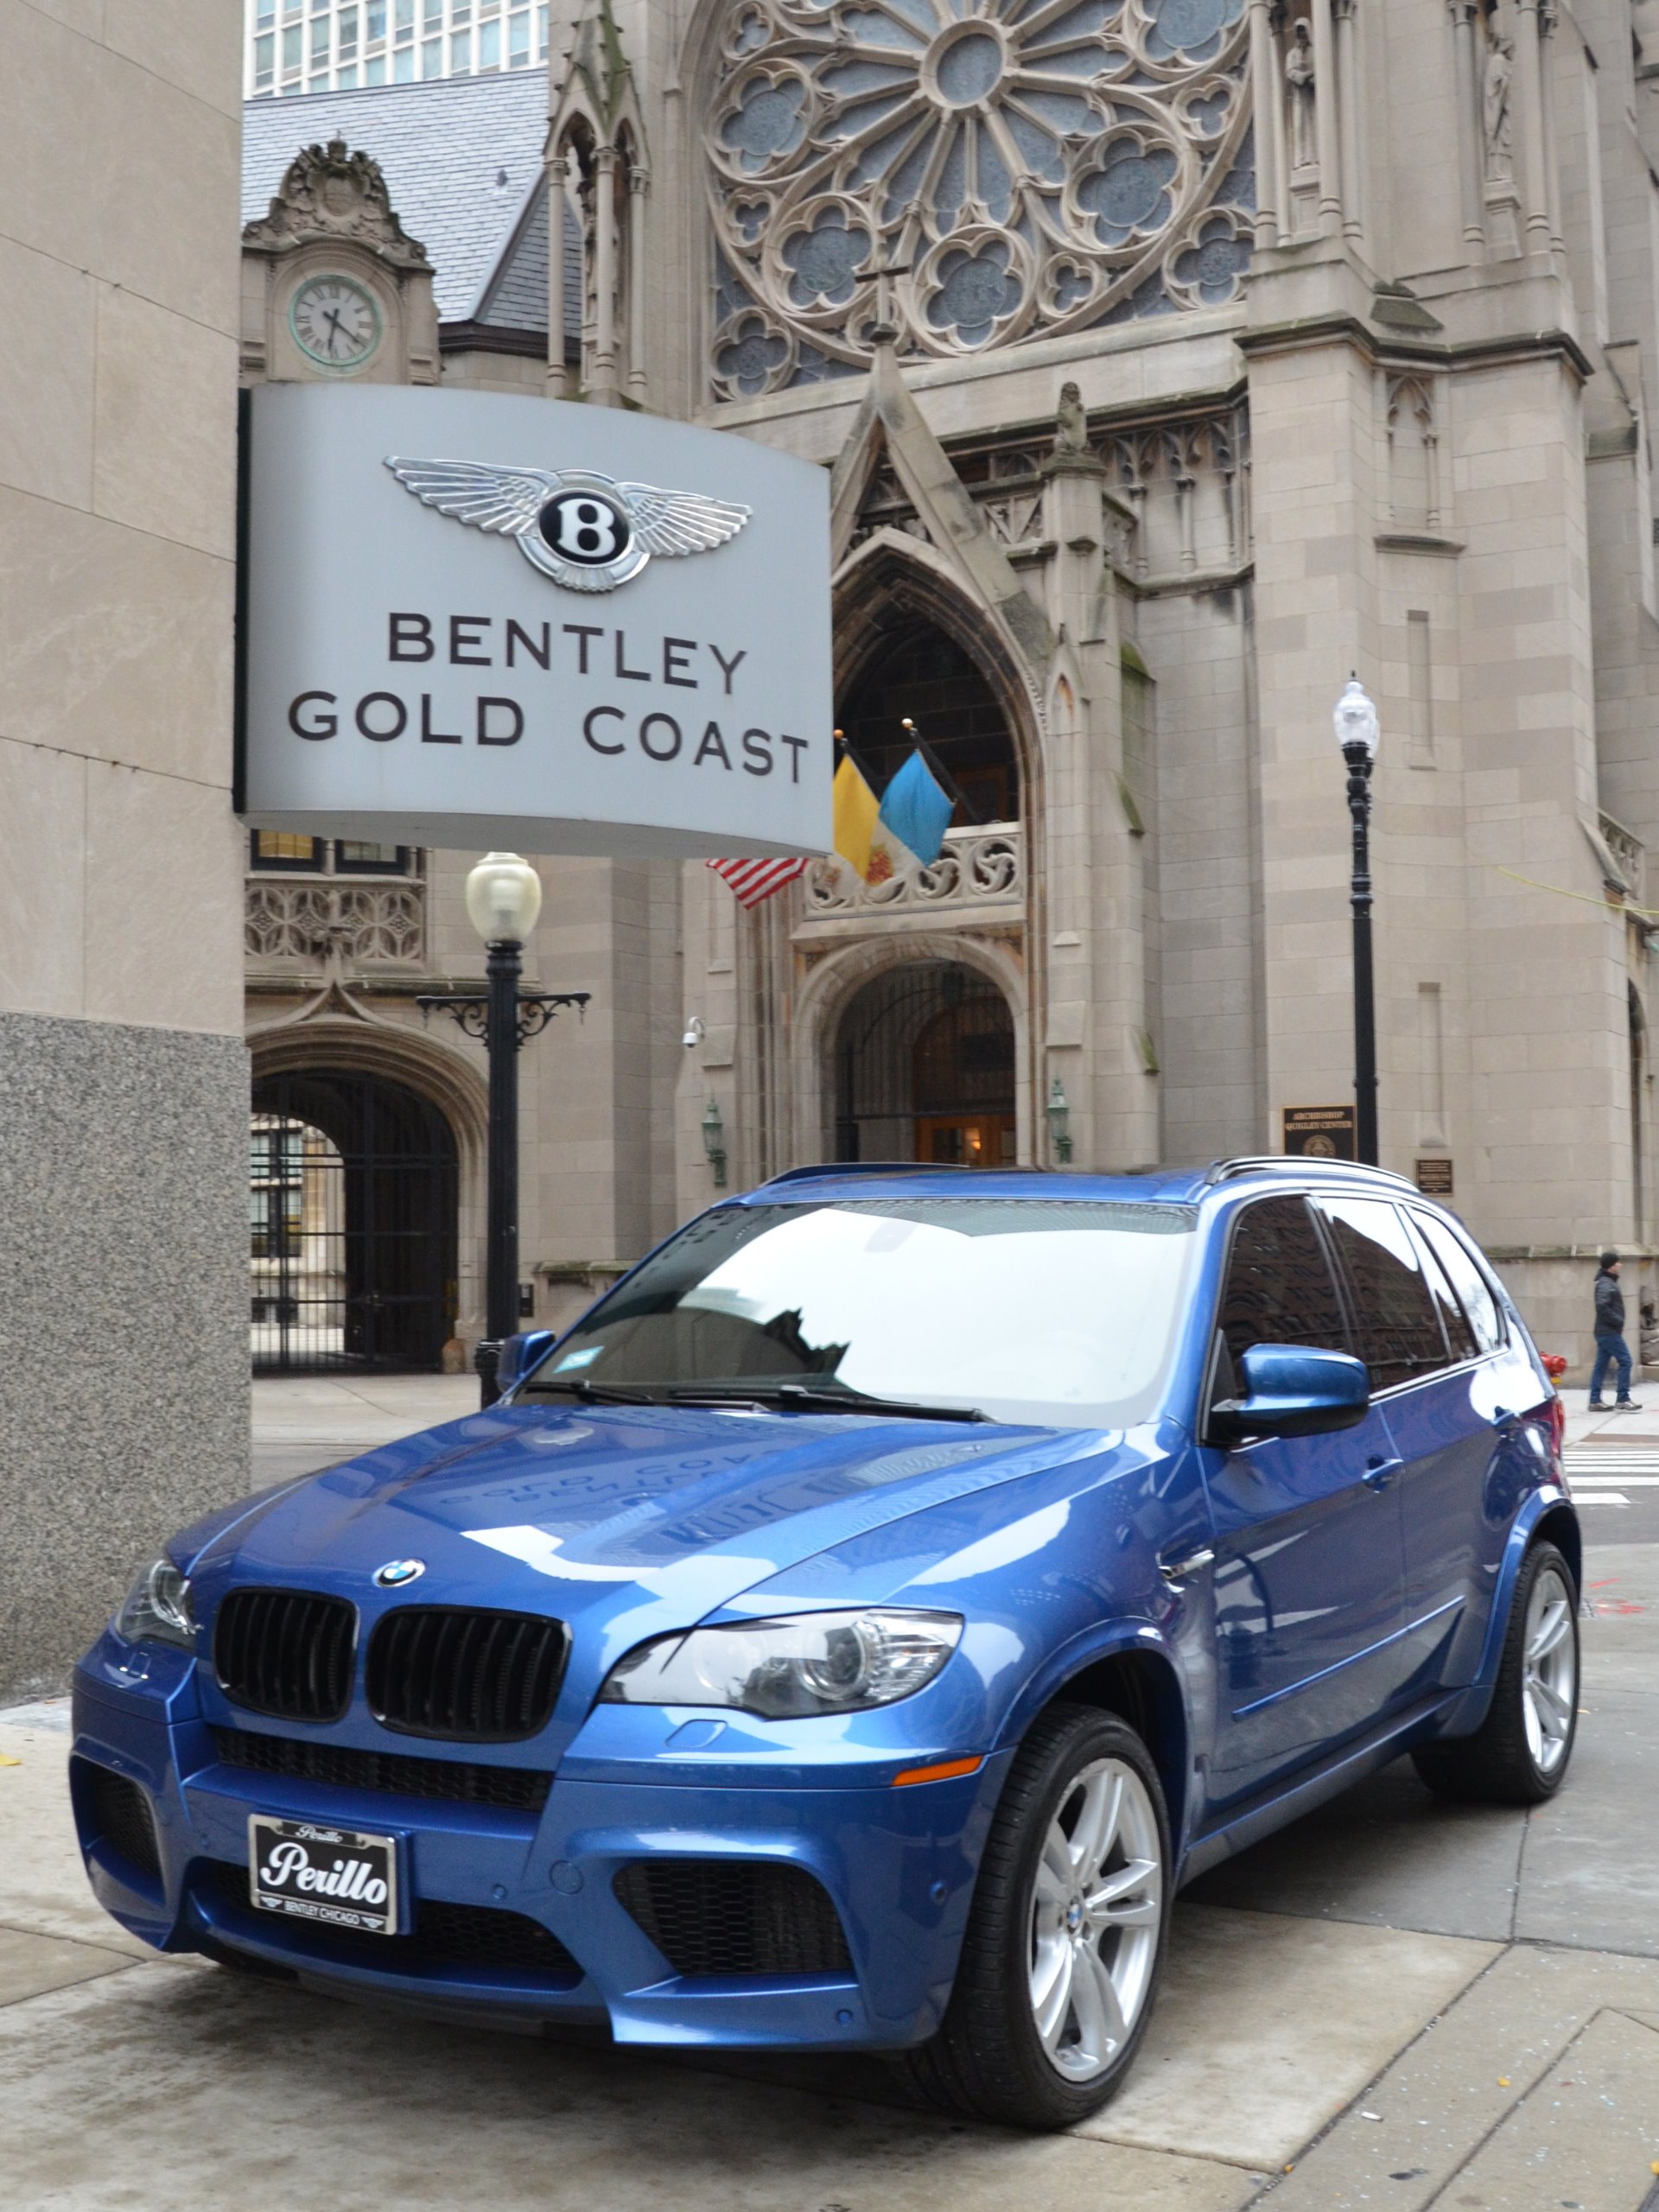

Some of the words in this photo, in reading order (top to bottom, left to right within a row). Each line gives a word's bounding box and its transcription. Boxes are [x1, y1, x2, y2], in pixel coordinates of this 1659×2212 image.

[556, 498, 615, 558] B
[388, 612, 747, 695] BENTLEY
[288, 690, 525, 747] GOLD
[583, 706, 809, 784] COAST
[295, 1825, 343, 1843] Perillo
[260, 1842, 387, 1904] Perillo
[284, 1900, 318, 1916] BENTLEY
[319, 1907, 359, 1925] CHICAGO
